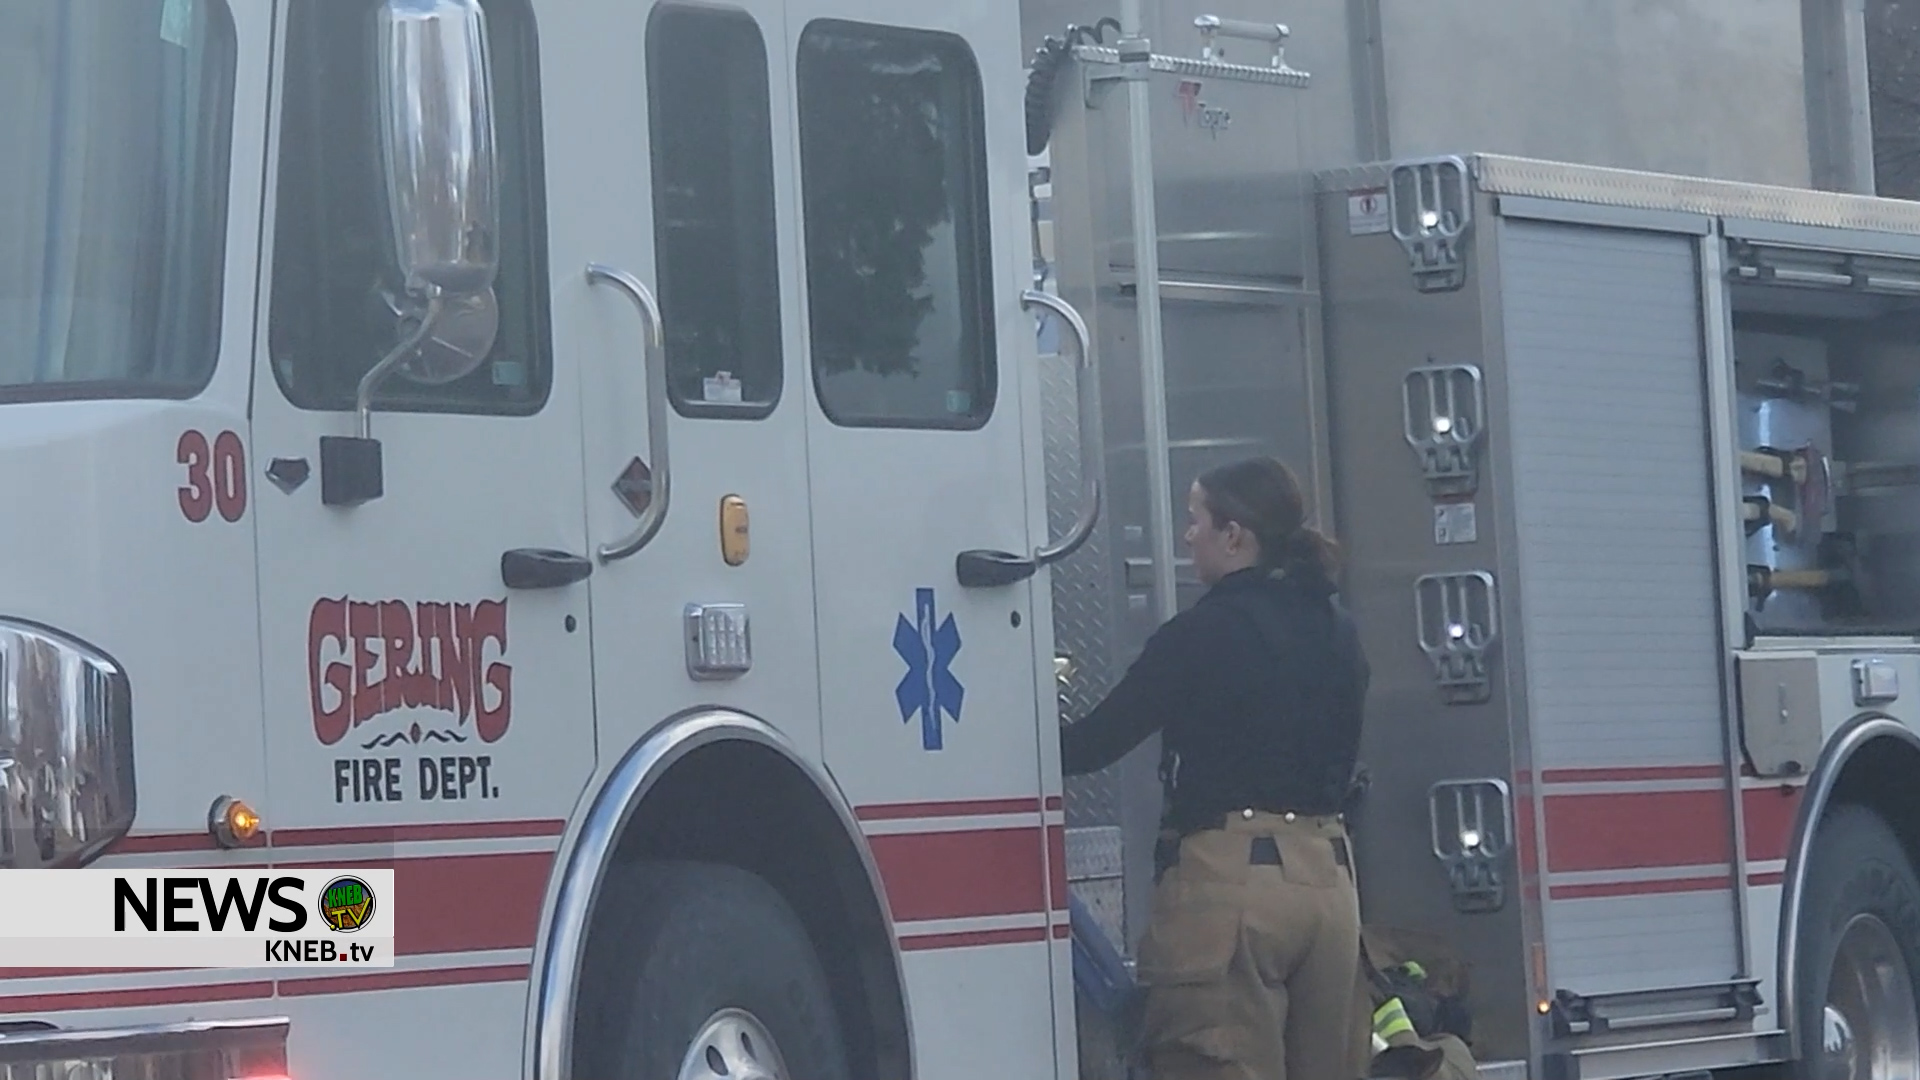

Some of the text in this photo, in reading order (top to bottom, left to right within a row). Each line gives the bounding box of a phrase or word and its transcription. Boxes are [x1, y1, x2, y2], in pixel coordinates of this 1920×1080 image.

[177, 429, 247, 523] 30
[308, 595, 512, 746] GERING
[334, 756, 499, 803] FIRE DEPT.
